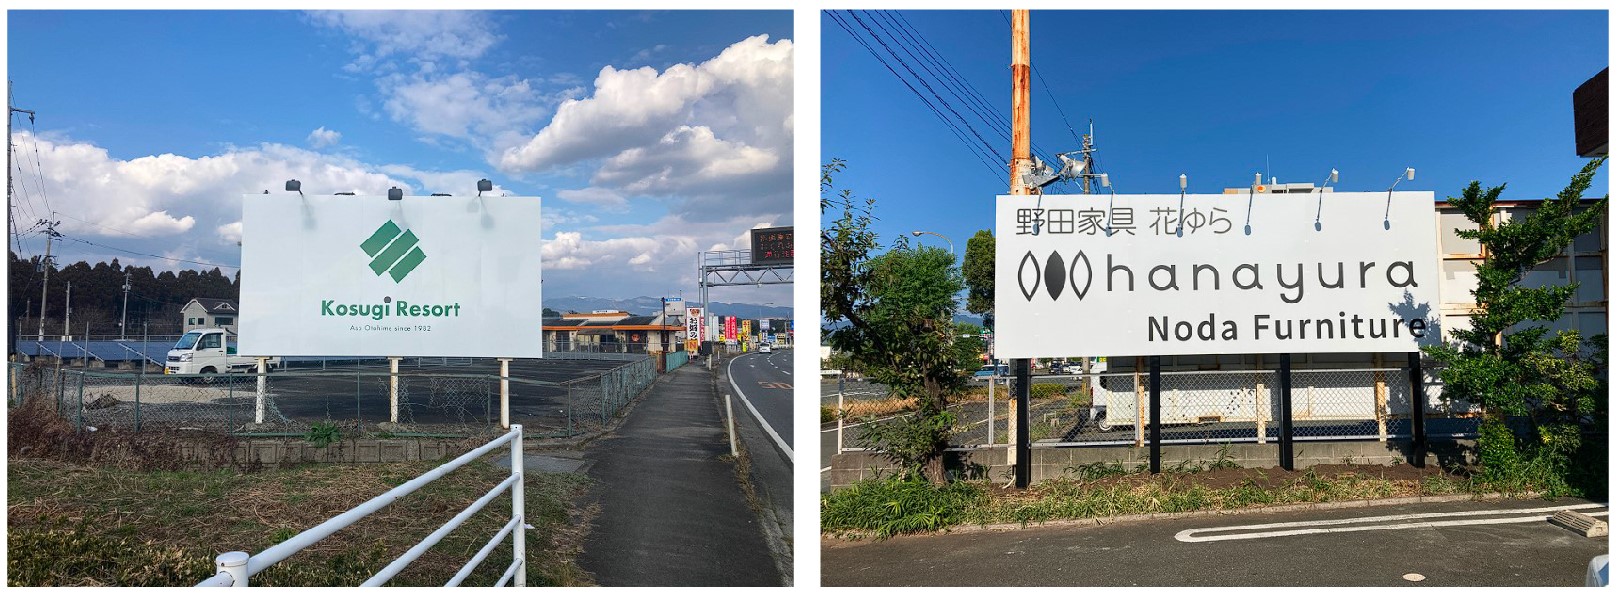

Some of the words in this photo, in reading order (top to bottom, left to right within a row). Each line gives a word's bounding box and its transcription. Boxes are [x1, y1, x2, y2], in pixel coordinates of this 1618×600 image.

[1016, 206, 1137, 236] 野田家具
[1149, 206, 1233, 236] 花ゆら
[1106, 253, 1419, 304] hanayura
[321, 296, 392, 321] Kosugi
[396, 300, 461, 317] Resort
[1148, 312, 1239, 342] Noda
[1253, 311, 1427, 341] Furniture
